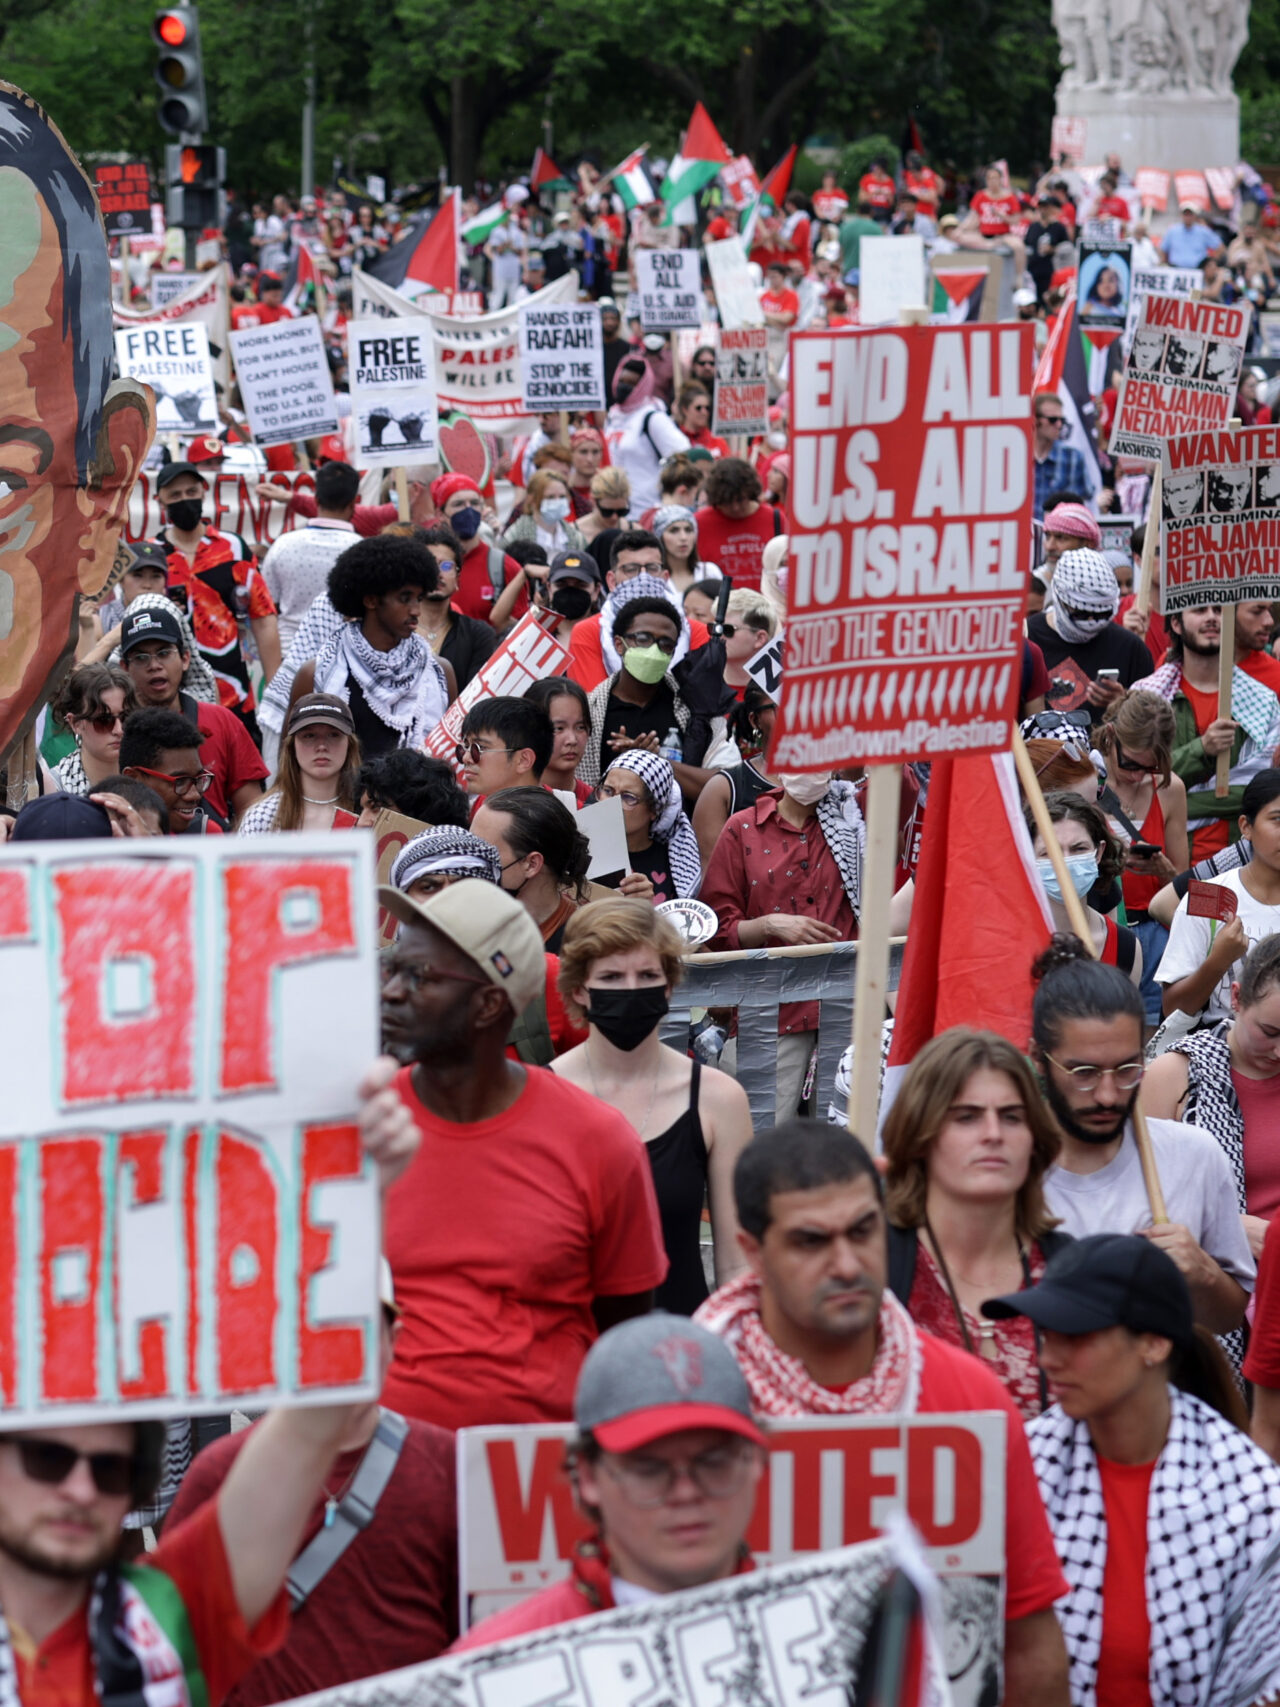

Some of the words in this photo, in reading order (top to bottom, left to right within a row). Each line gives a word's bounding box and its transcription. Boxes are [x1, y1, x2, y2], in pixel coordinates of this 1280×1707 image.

[651, 254, 683, 270] END
[655, 271, 683, 289] ALL
[526, 311, 569, 326] HANDS
[573, 311, 593, 325] OFF
[1145, 295, 1243, 339] WANTED
[127, 328, 196, 359] FREE
[238, 336, 270, 348] MORE
[273, 327, 313, 341] MONEY
[527, 328, 594, 350] RAFAH!
[358, 336, 421, 368] FREE
[441, 345, 515, 365] PALES
[128, 360, 206, 378] PALESTINE
[282, 362, 320, 376] HOUSE
[357, 365, 427, 384] PALESTINE
[531, 363, 565, 379] STOP
[569, 363, 593, 377] THE
[793, 333, 908, 430] END
[923, 330, 1031, 422] ALL
[527, 381, 598, 397] GENOCIDE!
[1128, 370, 1163, 385] WAR
[1163, 376, 1231, 396] CRIMINAL
[254, 404, 278, 414] END
[1123, 380, 1231, 422] BENJAMIN
[1167, 428, 1280, 470] WANTE
[793, 429, 895, 529] U.S.
[913, 424, 1028, 518] AID
[1167, 515, 1205, 530] WAR
[1209, 510, 1280, 524] CRIMINA
[1167, 520, 1280, 560] BENJAMI
[789, 529, 842, 607] TO
[849, 521, 1024, 599] ISRAEL
[1167, 548, 1280, 587] NETANYAH
[1166, 585, 1280, 611] ANSWERCOALITION.O
[787, 618, 840, 668] STOP
[842, 611, 886, 659] THE
[893, 605, 1020, 656] GENOCIDE
[486, 1426, 983, 1562] WTED
